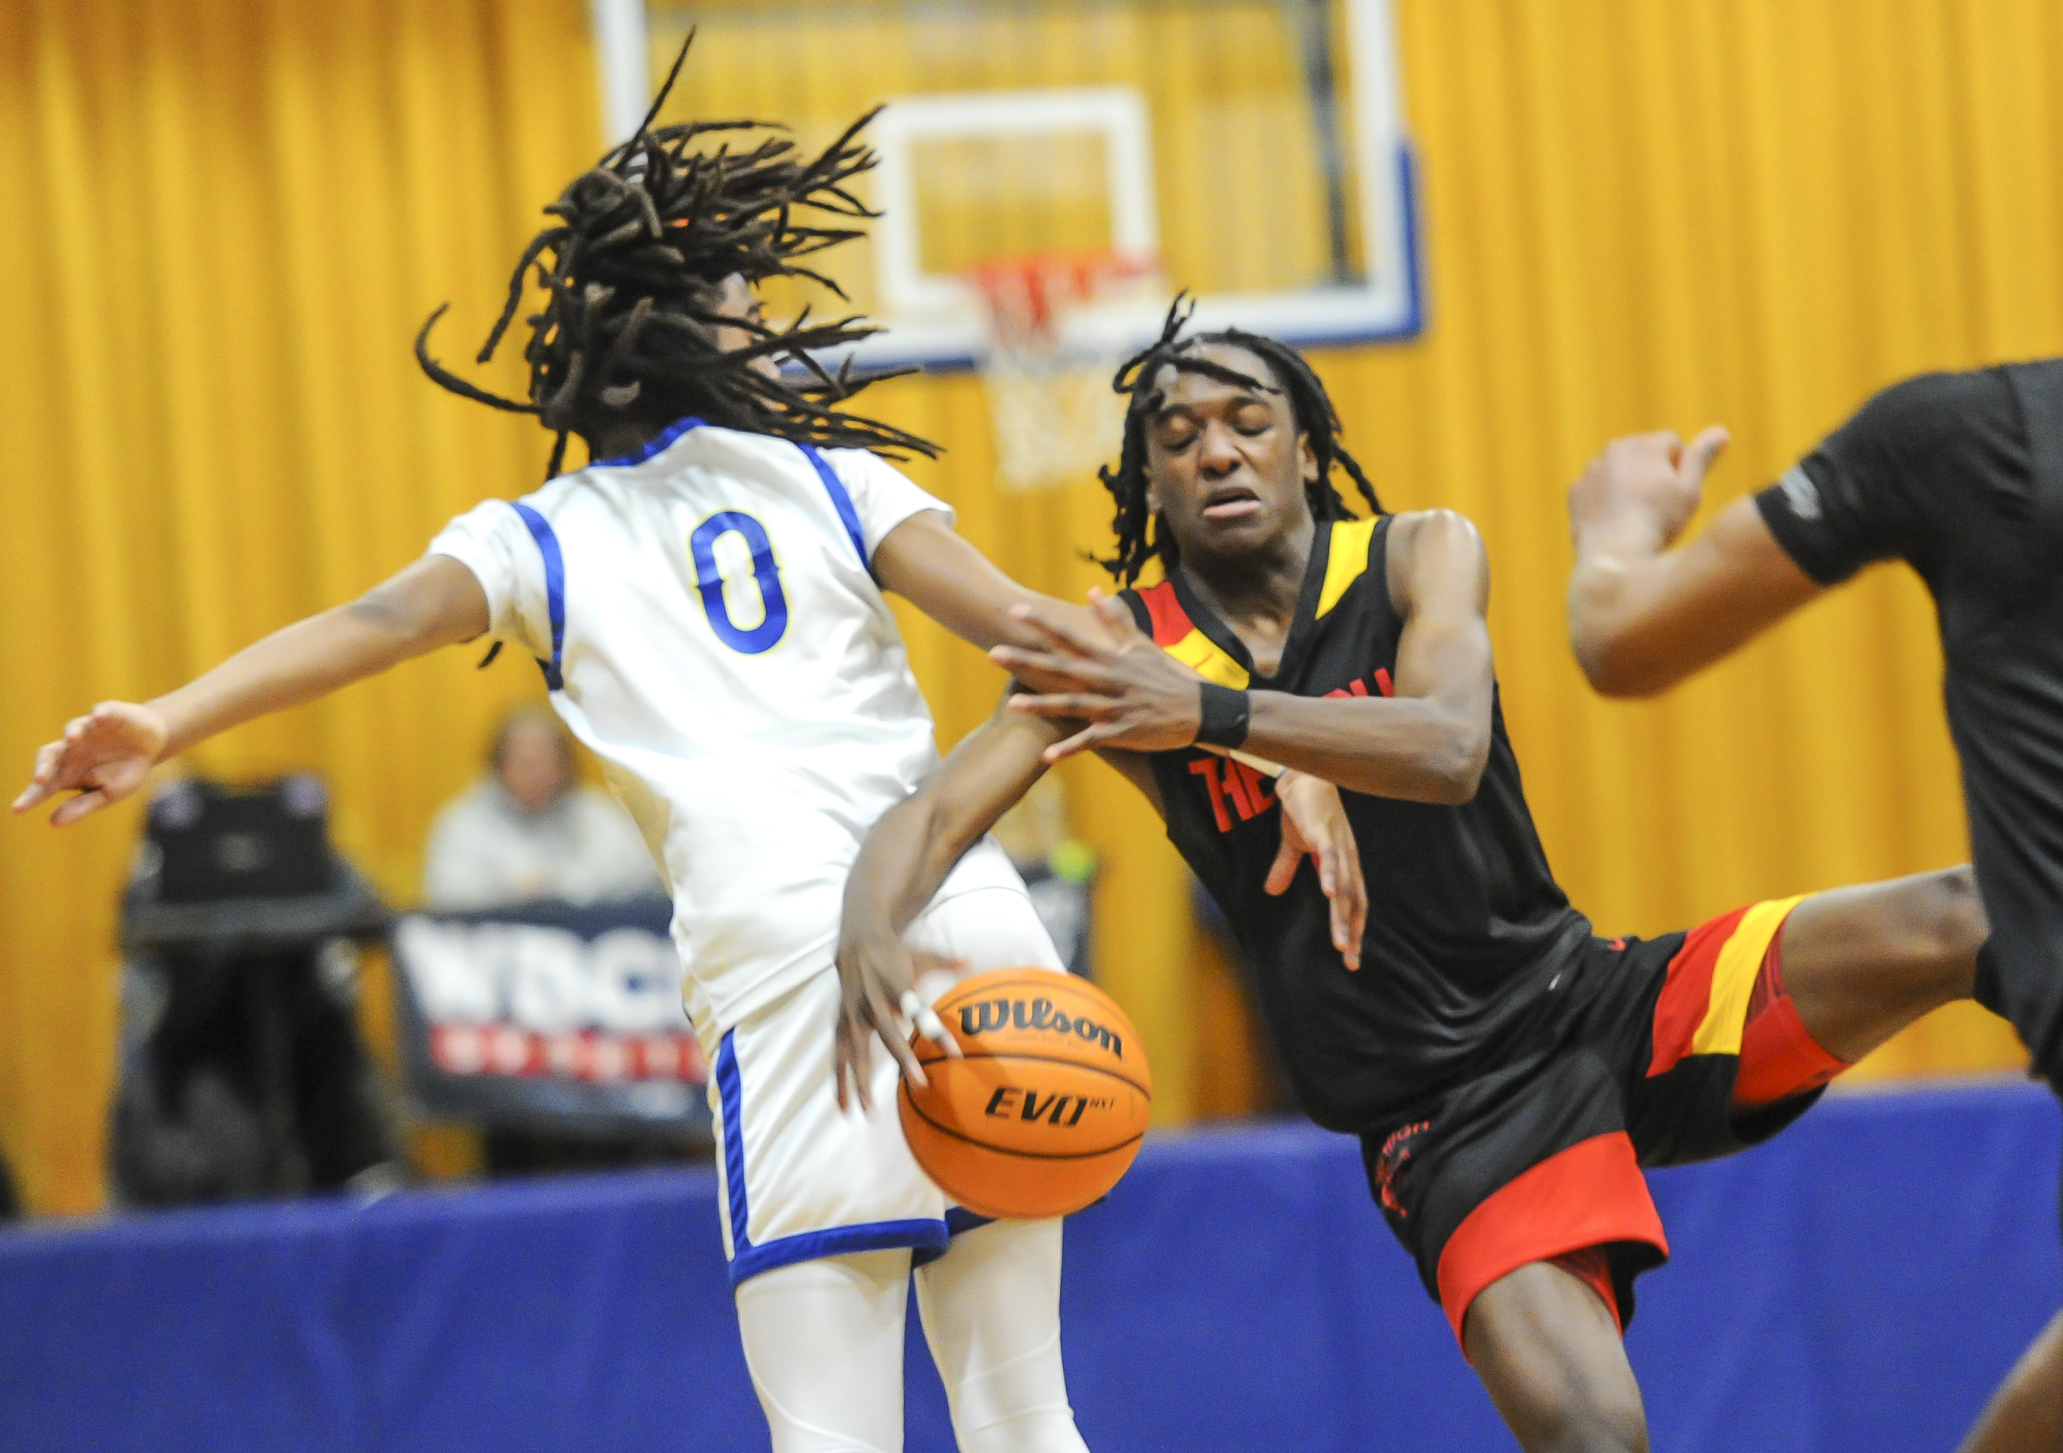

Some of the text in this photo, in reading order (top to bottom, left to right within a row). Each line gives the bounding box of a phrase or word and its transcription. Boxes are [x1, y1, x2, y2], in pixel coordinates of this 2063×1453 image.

[689, 508, 790, 656] 0
[958, 997, 1122, 1062] Wilson
[985, 1086, 1088, 1127] EVO
